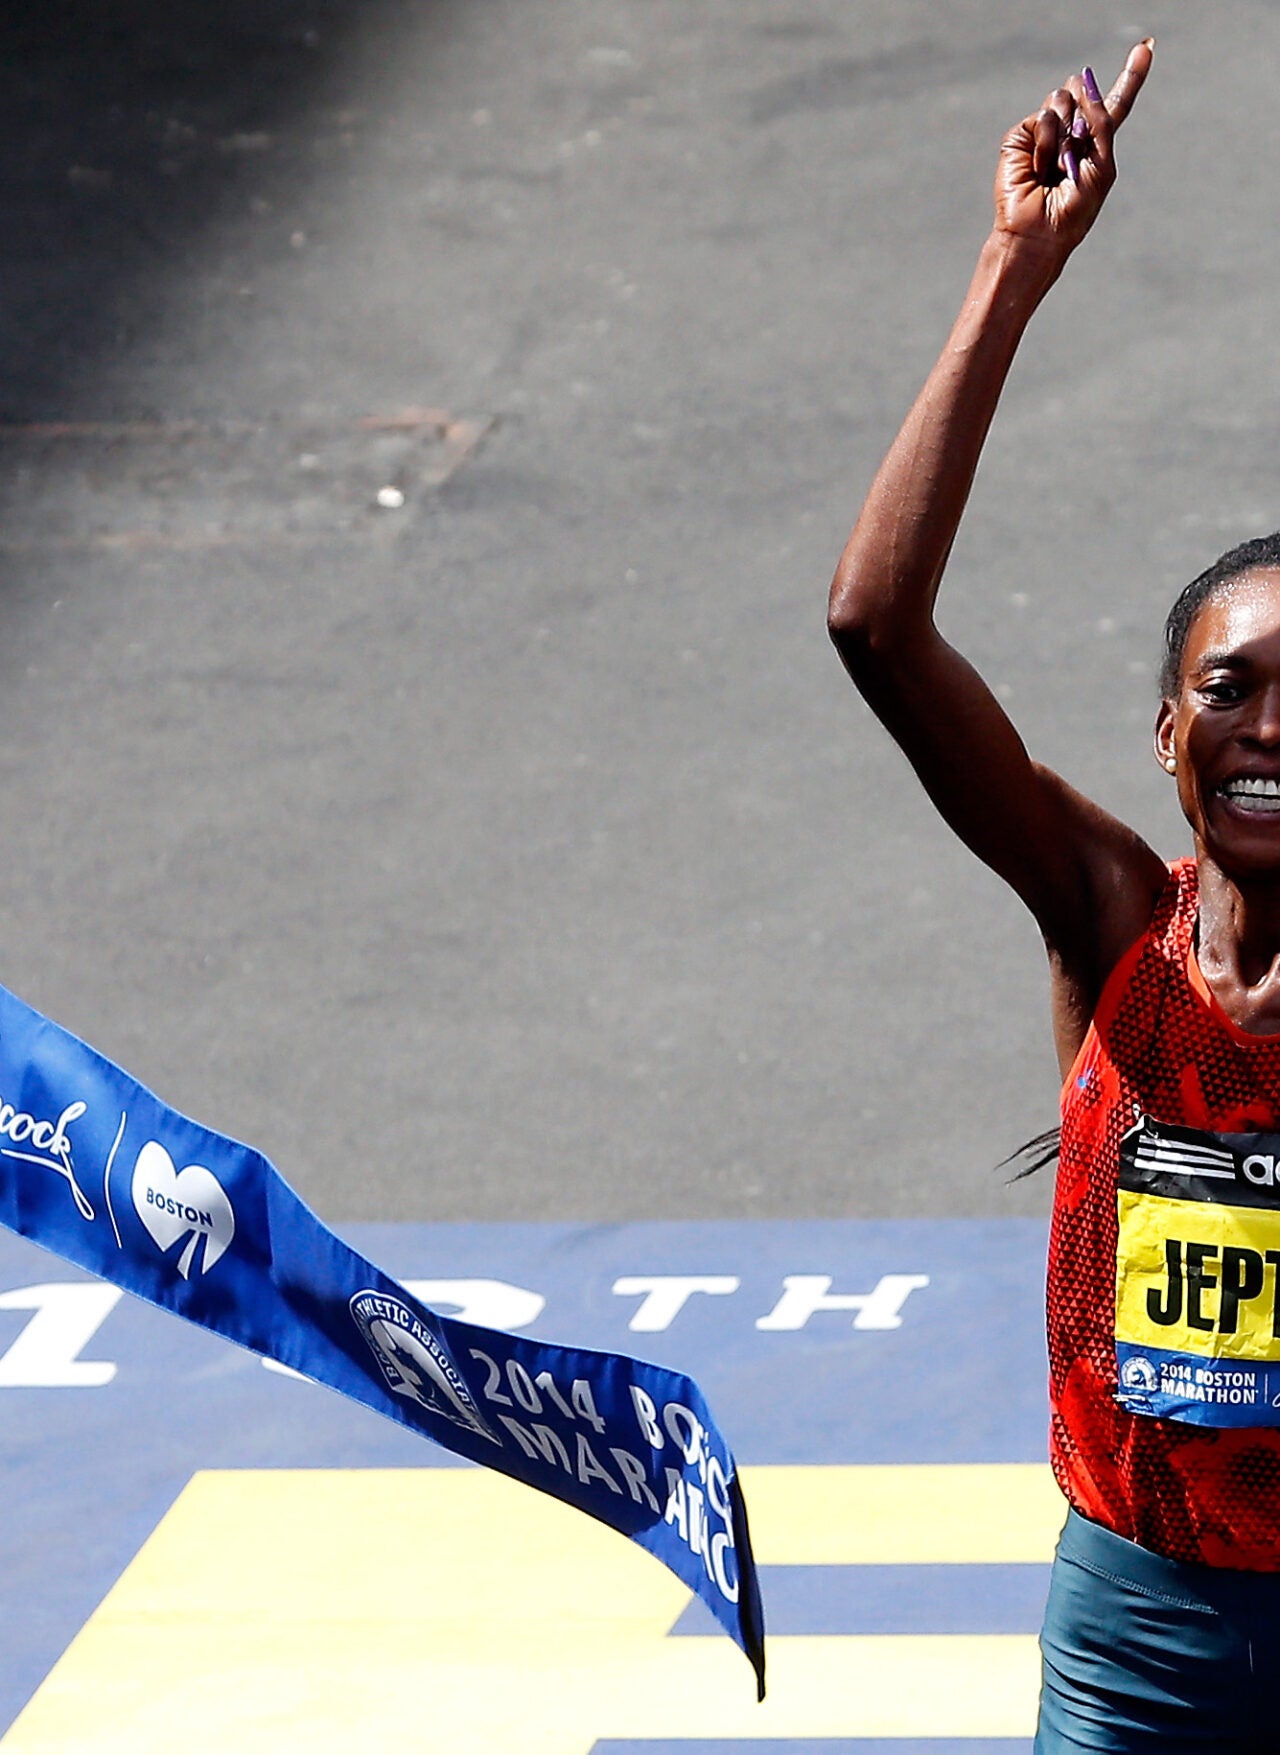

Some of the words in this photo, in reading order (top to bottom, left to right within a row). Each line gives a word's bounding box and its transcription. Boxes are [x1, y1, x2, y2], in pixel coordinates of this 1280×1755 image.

[146, 1187, 214, 1228] BOSTON
[469, 1348, 606, 1434] 2014
[1160, 1363, 1192, 1382] 2014
[1195, 1368, 1256, 1388] BOSTON
[1160, 1378, 1256, 1405] MARATHON
